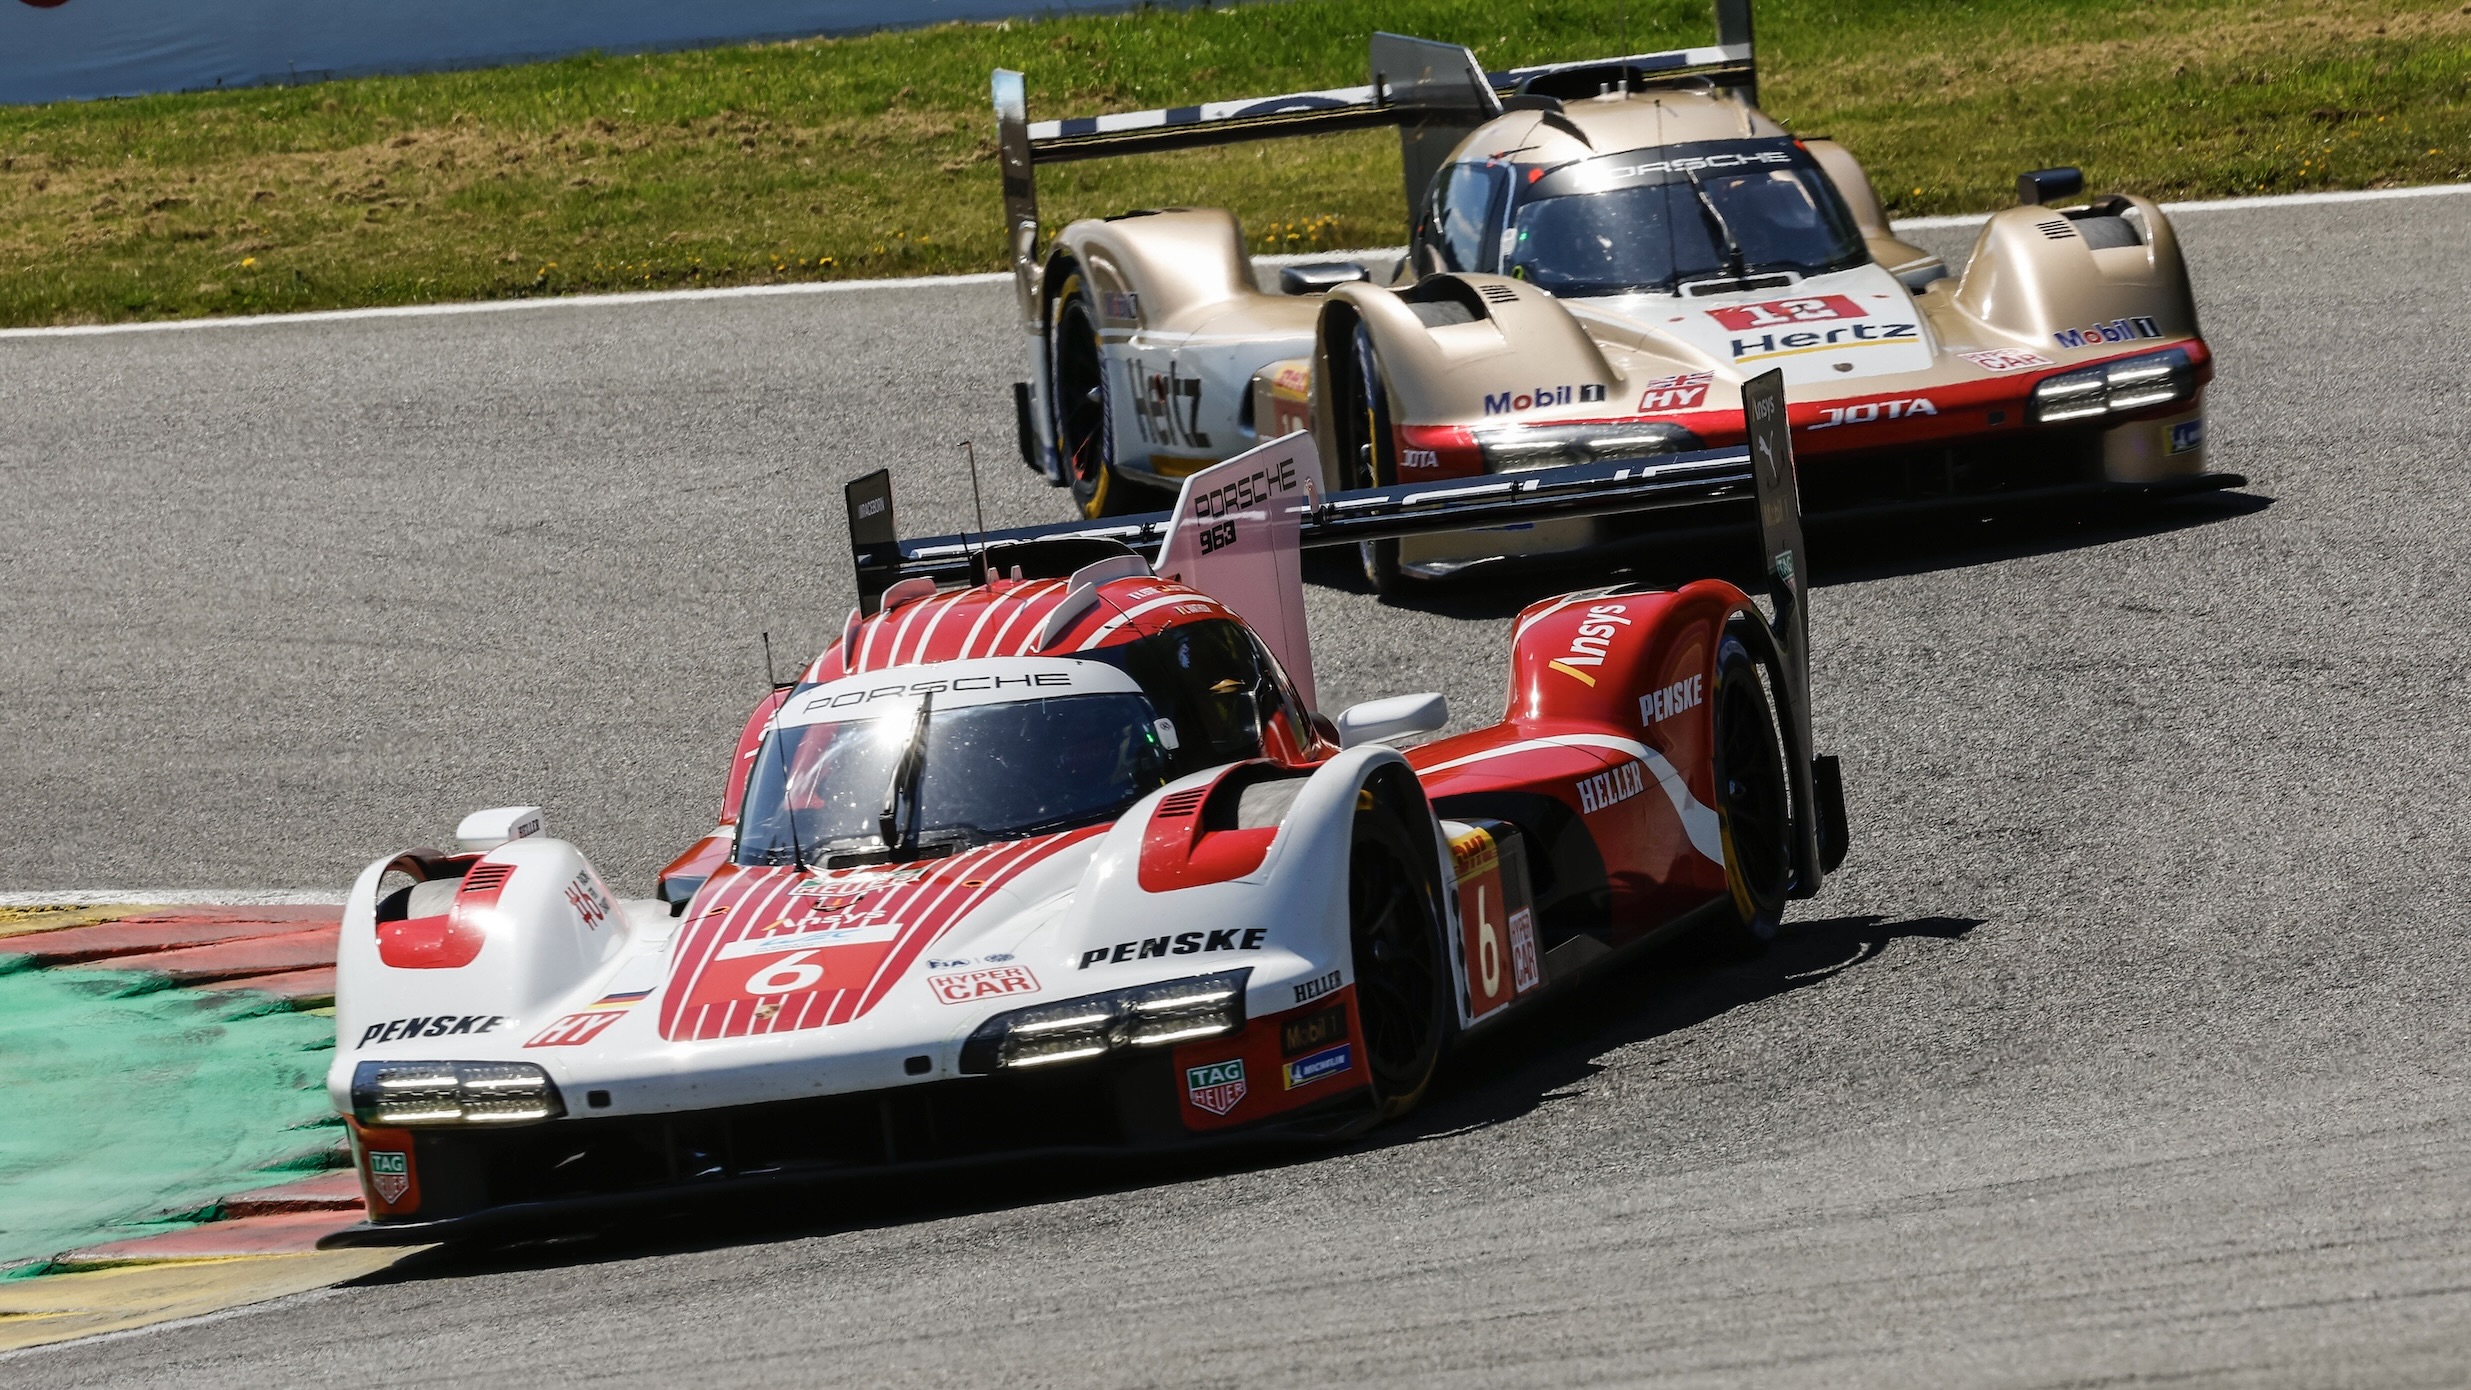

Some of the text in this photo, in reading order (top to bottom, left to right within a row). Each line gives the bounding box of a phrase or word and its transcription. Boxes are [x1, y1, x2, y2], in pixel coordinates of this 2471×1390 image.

[1739, 298, 1840, 327] 12
[1729, 323, 1919, 358] Hertz
[2052, 318, 2137, 349] Mobil
[1127, 357, 1213, 449] Hertz
[1484, 385, 1571, 416] Mobil
[1641, 386, 1705, 412] HY
[1807, 398, 1939, 431] JOTA
[1194, 457, 1298, 526] PORSCHE
[1200, 519, 1237, 556] 963
[1548, 604, 1632, 688] Ansys
[803, 673, 1073, 715] PORSCHE
[1639, 673, 1703, 727] PENSKE
[1576, 760, 1644, 814] HELLER
[761, 910, 887, 932] Ansys
[1077, 928, 1268, 970] PENSKE
[1478, 884, 1499, 998] 6
[745, 949, 825, 995] 6
[937, 968, 1024, 986] HYPER
[942, 977, 1033, 1001] CAR
[1293, 970, 1342, 1004] HELLER
[355, 1014, 507, 1050] PENSKE
[533, 1011, 617, 1047] HY
[1193, 1064, 1240, 1087] TAG
[1194, 1083, 1245, 1112] HEUER
[372, 1155, 402, 1171] TAG
